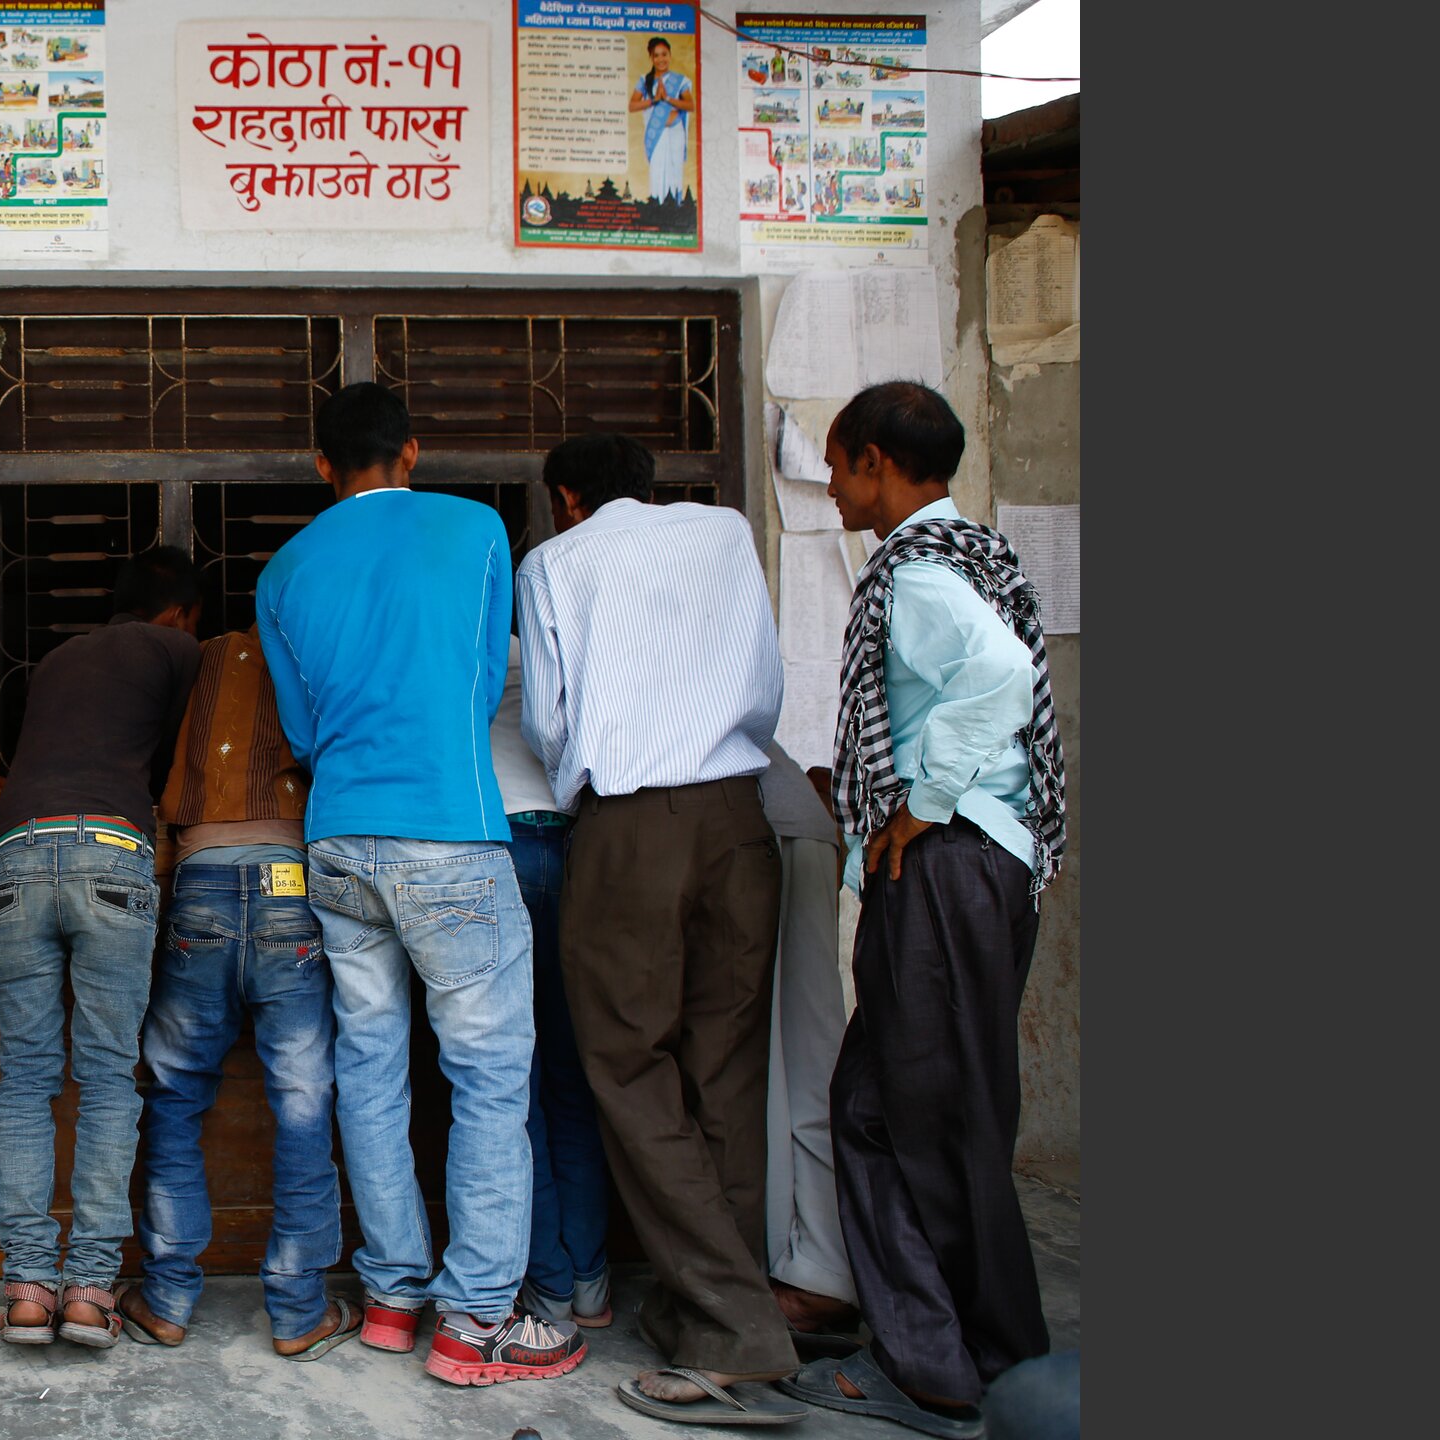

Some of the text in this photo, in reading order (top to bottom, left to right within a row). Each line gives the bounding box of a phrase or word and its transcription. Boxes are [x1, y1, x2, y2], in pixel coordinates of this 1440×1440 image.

[207, 33, 339, 89] कोठा
[192, 94, 469, 152] राहदानी फारम
[225, 151, 461, 212] बुझाउने ठाउँ
[510, 1347, 567, 1364] YICHENG
